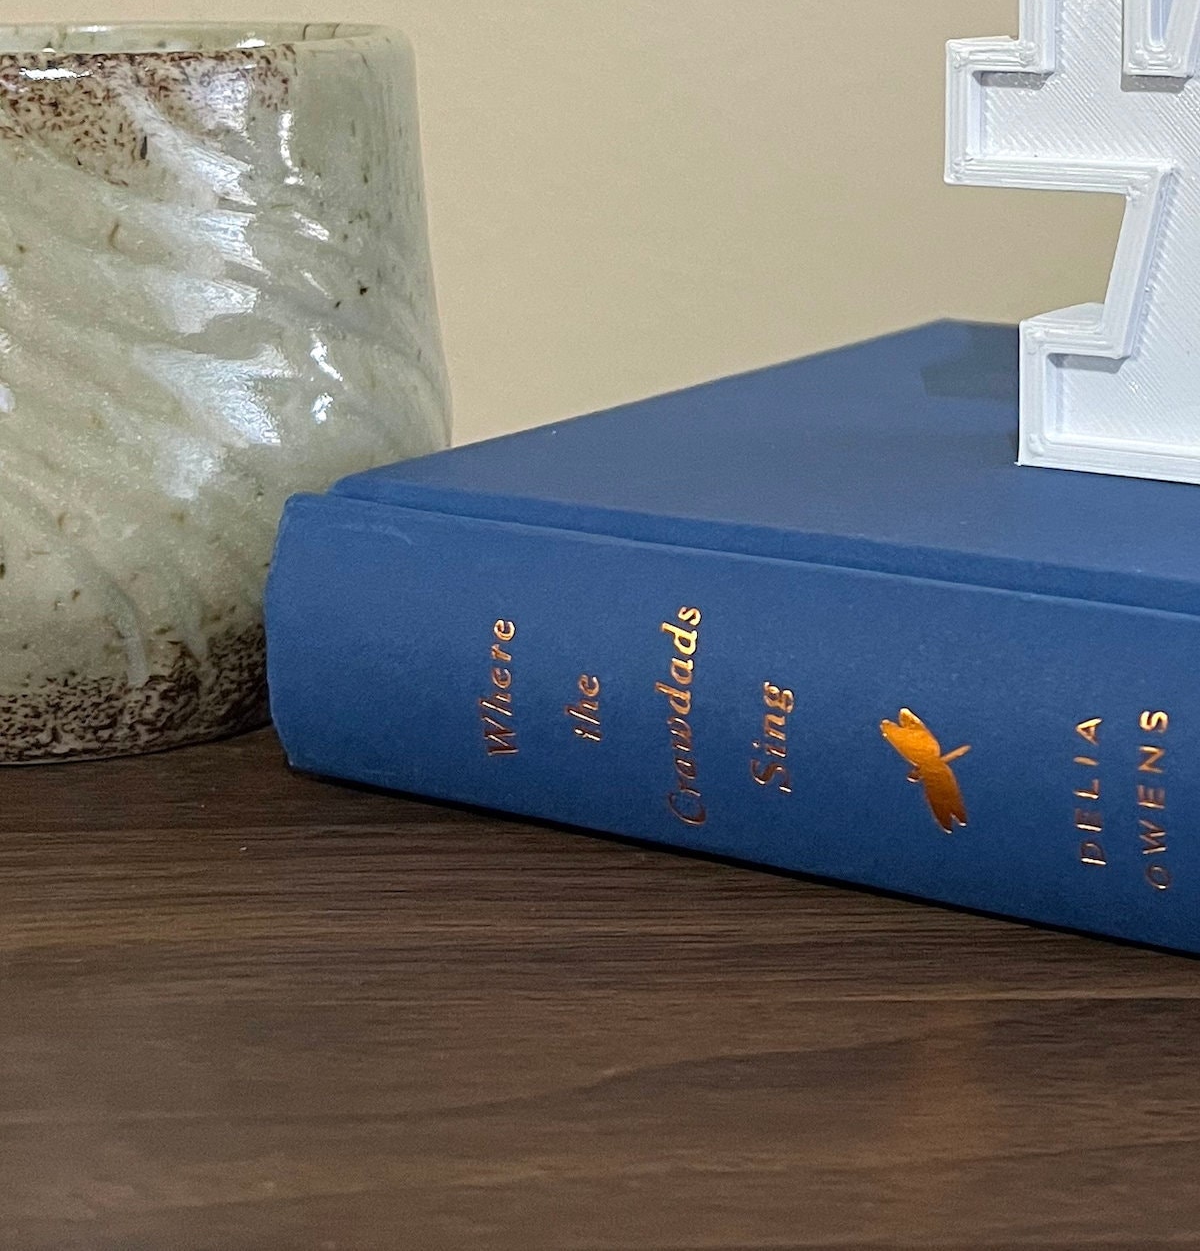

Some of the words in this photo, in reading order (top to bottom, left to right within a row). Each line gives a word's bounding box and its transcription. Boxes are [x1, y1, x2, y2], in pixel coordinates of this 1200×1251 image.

[478, 617, 518, 757] Where
[564, 673, 602, 742] the
[654, 605, 707, 826] Crawdads
[751, 680, 795, 794] Sing
[1073, 716, 1107, 866] DELIA
[1137, 709, 1171, 891] OWENS
